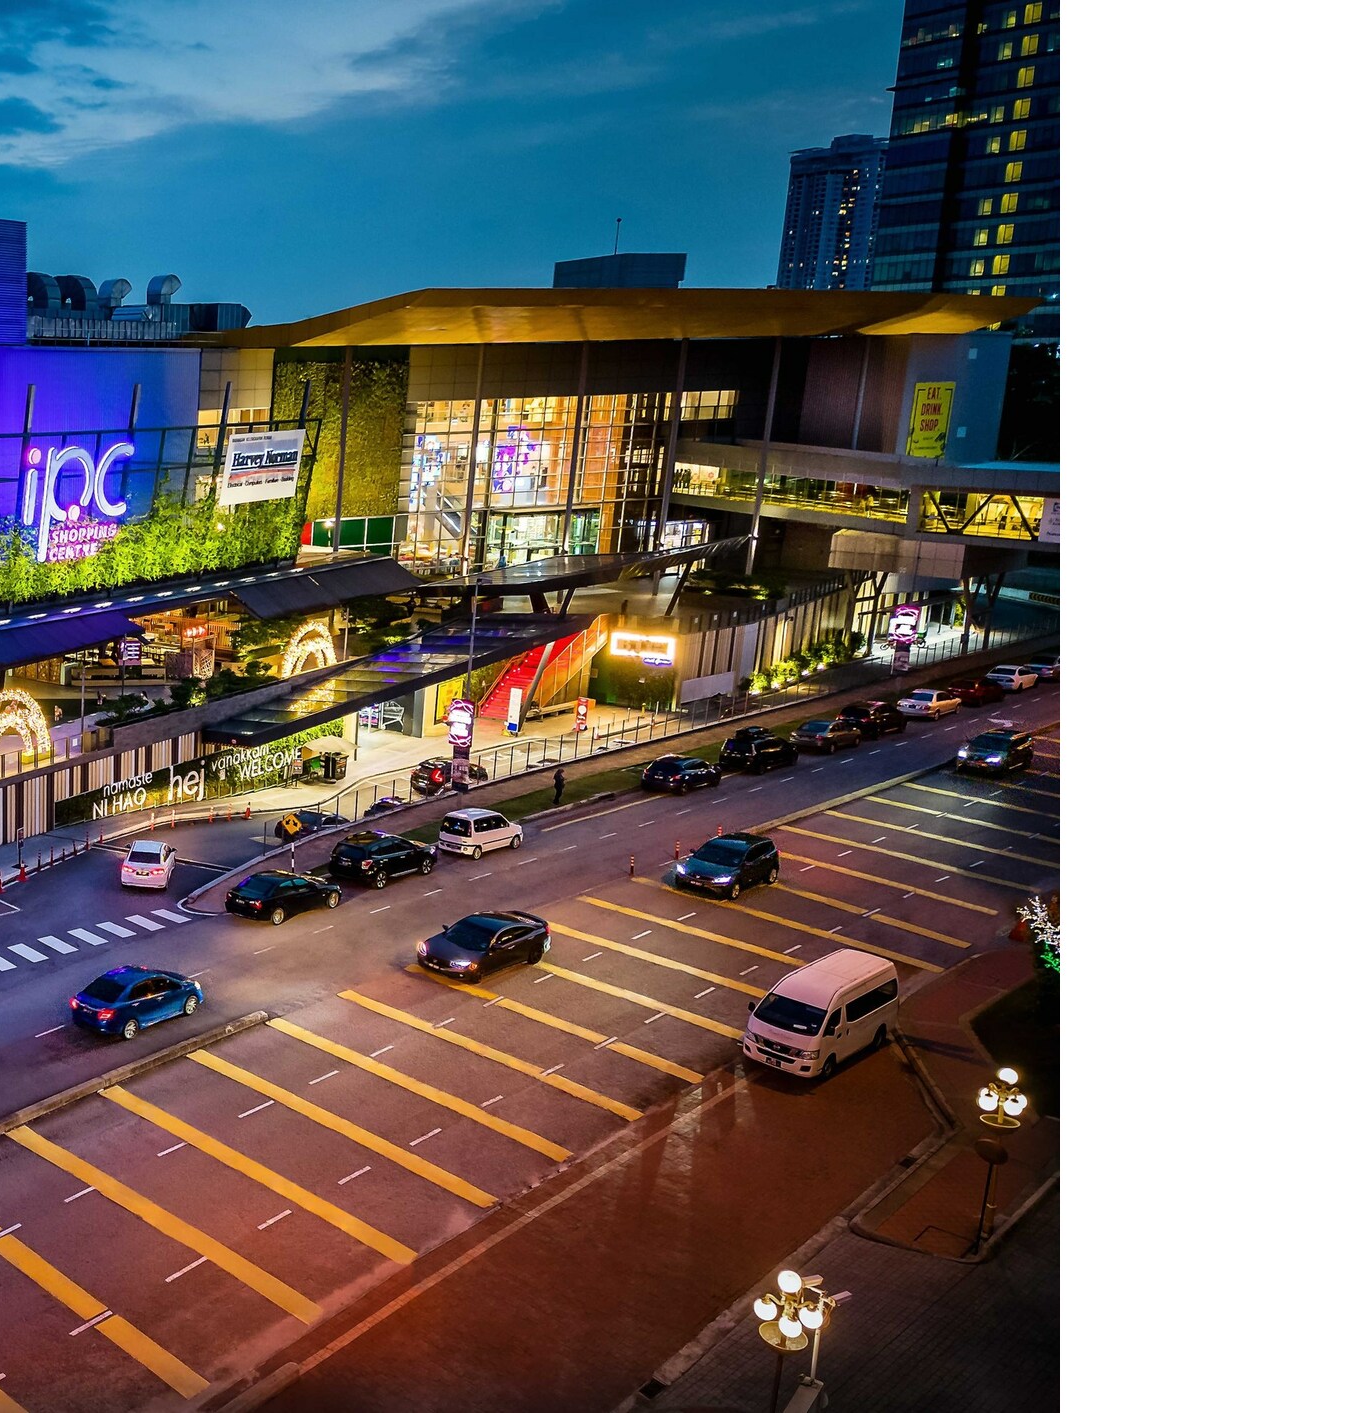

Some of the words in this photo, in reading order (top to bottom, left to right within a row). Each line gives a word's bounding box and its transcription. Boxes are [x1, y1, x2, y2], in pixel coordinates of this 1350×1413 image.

[232, 452, 265, 468] Harvey
[265, 448, 299, 464] Norman
[23, 442, 135, 562] ipc
[211, 743, 270, 772] vanakkam
[238, 746, 302, 781] WELCOME
[103, 771, 153, 797] namaste
[169, 759, 206, 801] hej
[92, 798, 108, 820] NI
[112, 786, 147, 814] HAO
